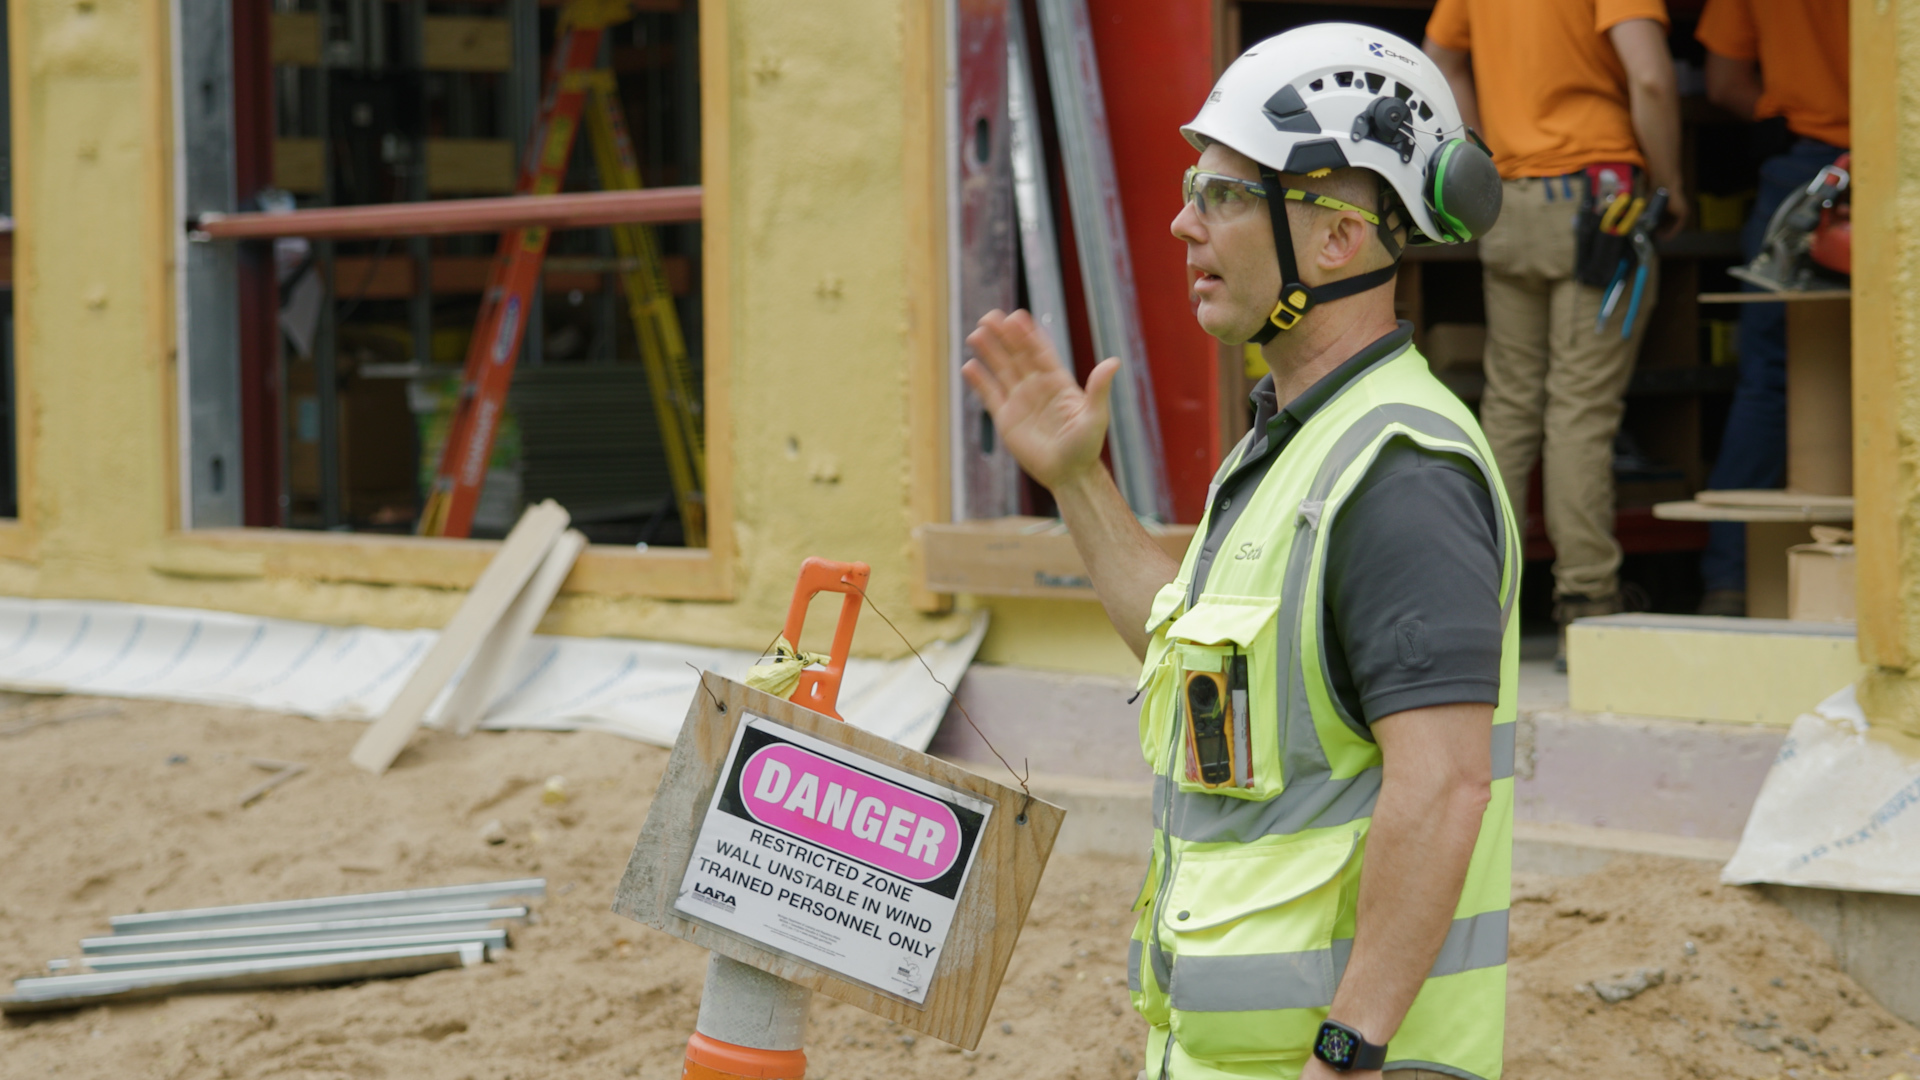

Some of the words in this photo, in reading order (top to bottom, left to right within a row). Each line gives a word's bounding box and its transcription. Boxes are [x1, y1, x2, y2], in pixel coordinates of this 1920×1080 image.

[753, 757, 946, 866] DANGER
[694, 882, 736, 907] LARA
[699, 856, 774, 897] TRAINED
[777, 887, 882, 941] PERSONNEL
[888, 931, 937, 959] ONLY
[716, 839, 762, 870] WALL
[767, 859, 859, 906] UNSTABLE
[862, 896, 881, 915] IN
[885, 907, 932, 934] WIND
[750, 829, 859, 881] RESTRICTED
[862, 872, 913, 903] ZONE
